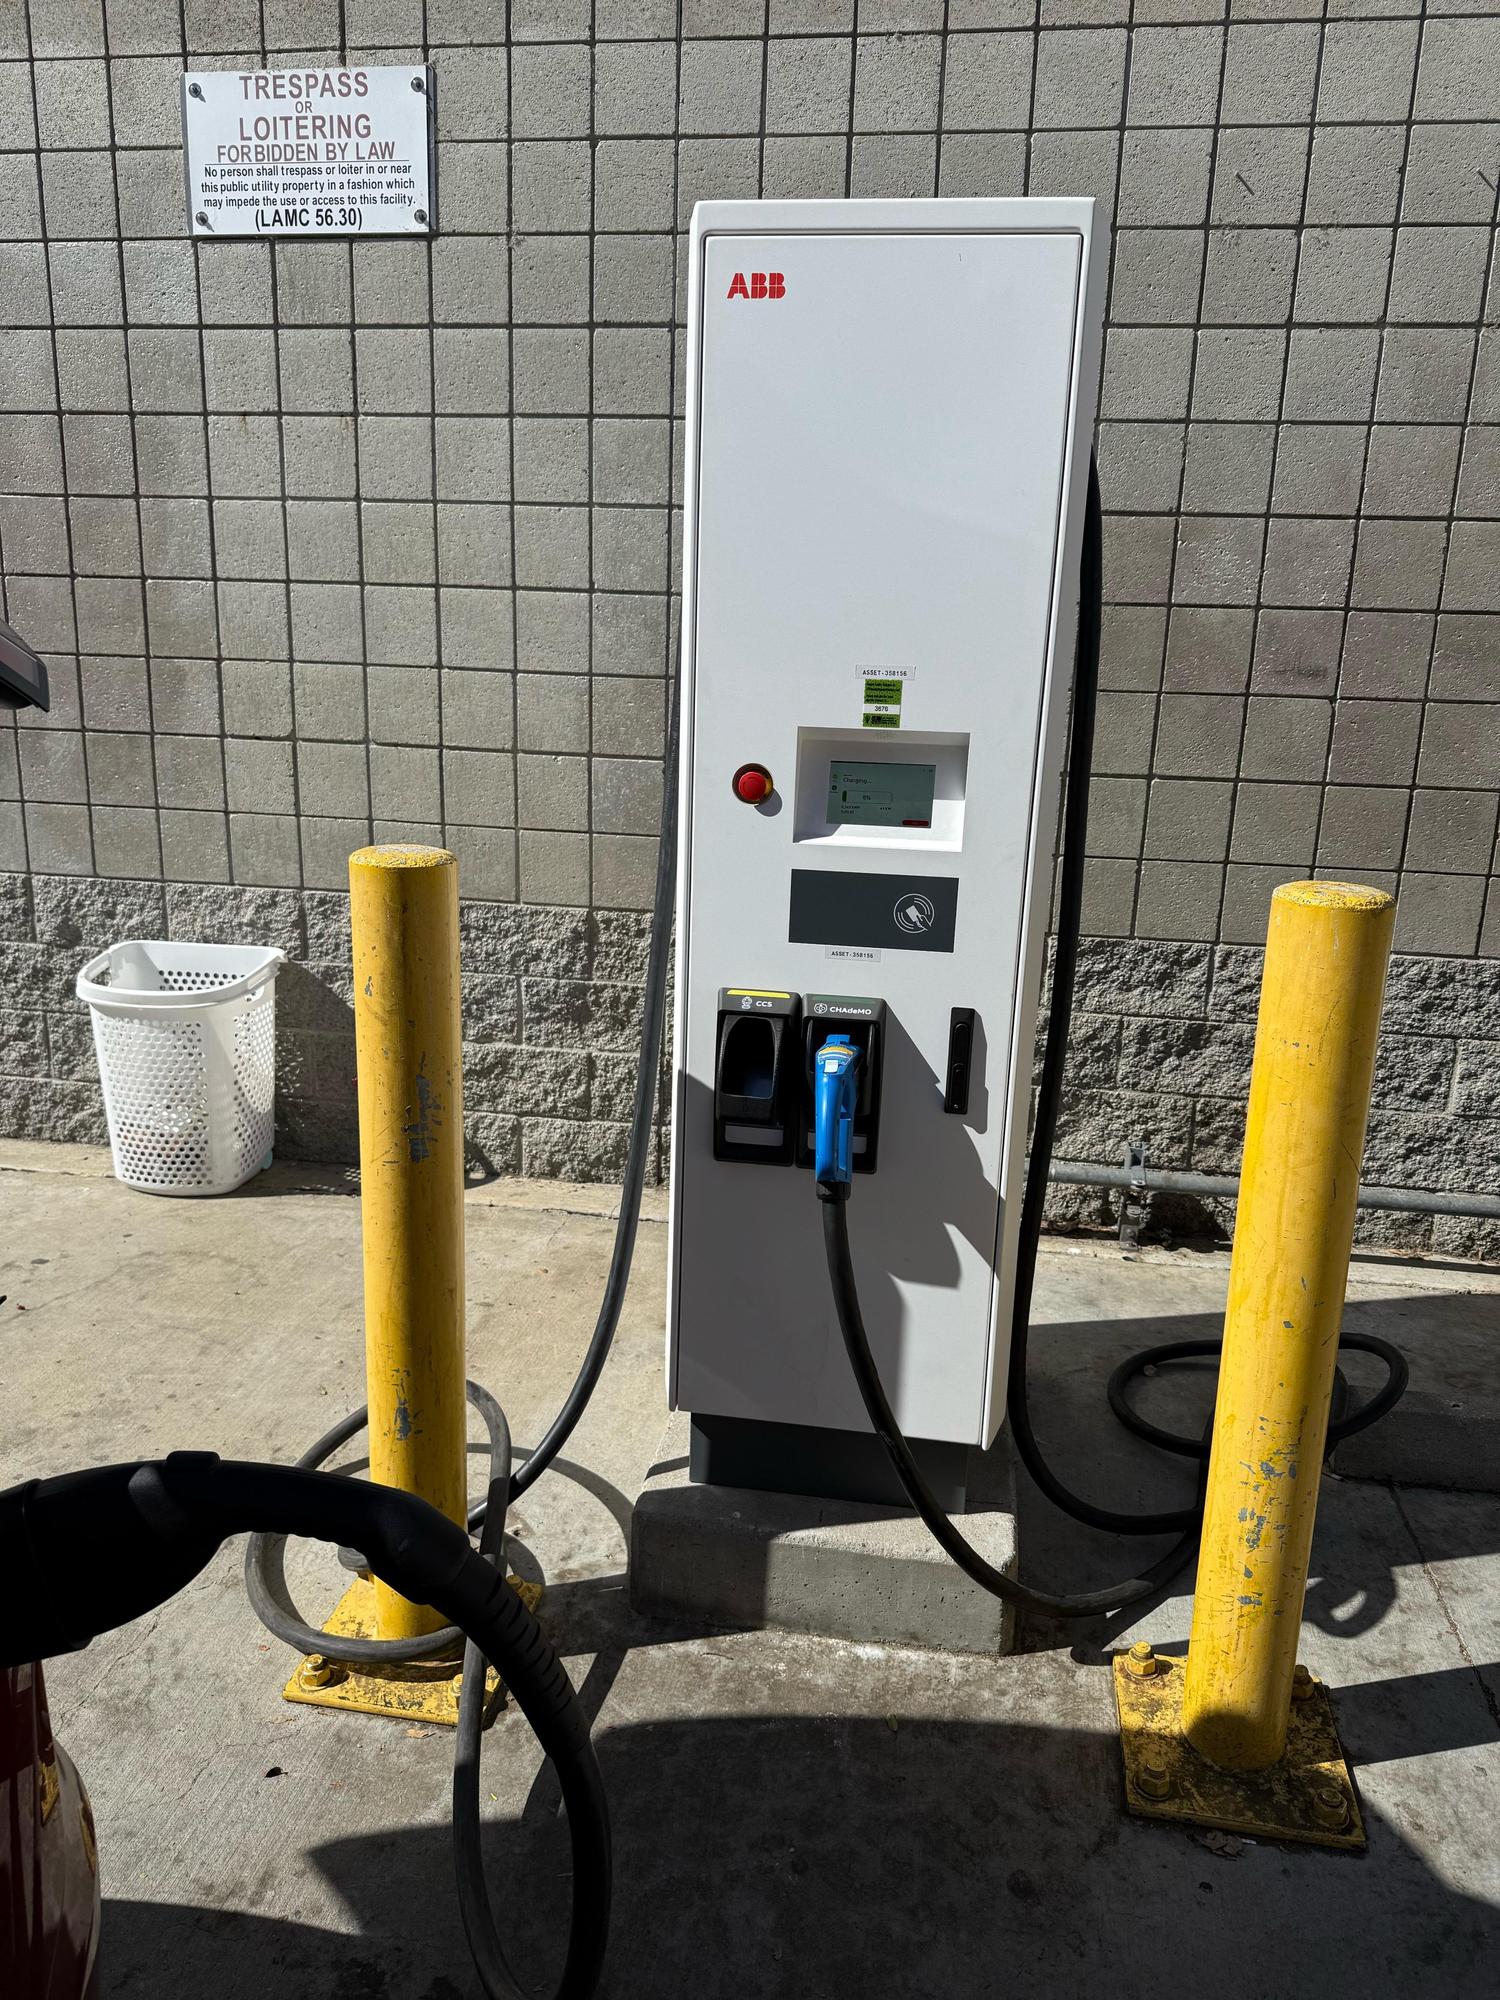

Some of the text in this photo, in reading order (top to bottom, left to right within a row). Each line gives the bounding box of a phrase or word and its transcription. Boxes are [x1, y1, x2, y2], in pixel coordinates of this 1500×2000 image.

[239, 71, 369, 100] TRESPASS
[295, 101, 313, 113] OR
[239, 113, 371, 141] LOITERING
[217, 141, 395, 163] FORBIDDEN BY LAW
[205, 164, 412, 180] No person shall trespass or loiter in or near
[201, 178, 415, 194] this public utility property in a fashion which
[204, 194, 416, 209] may impede the use or access to this facility.
[255, 208, 363, 232] (LAMC 56.30)
[726, 272, 786, 299] ABB
[755, 1000, 773, 1008] CCS
[829, 1006, 872, 1015] CHAdeMO
